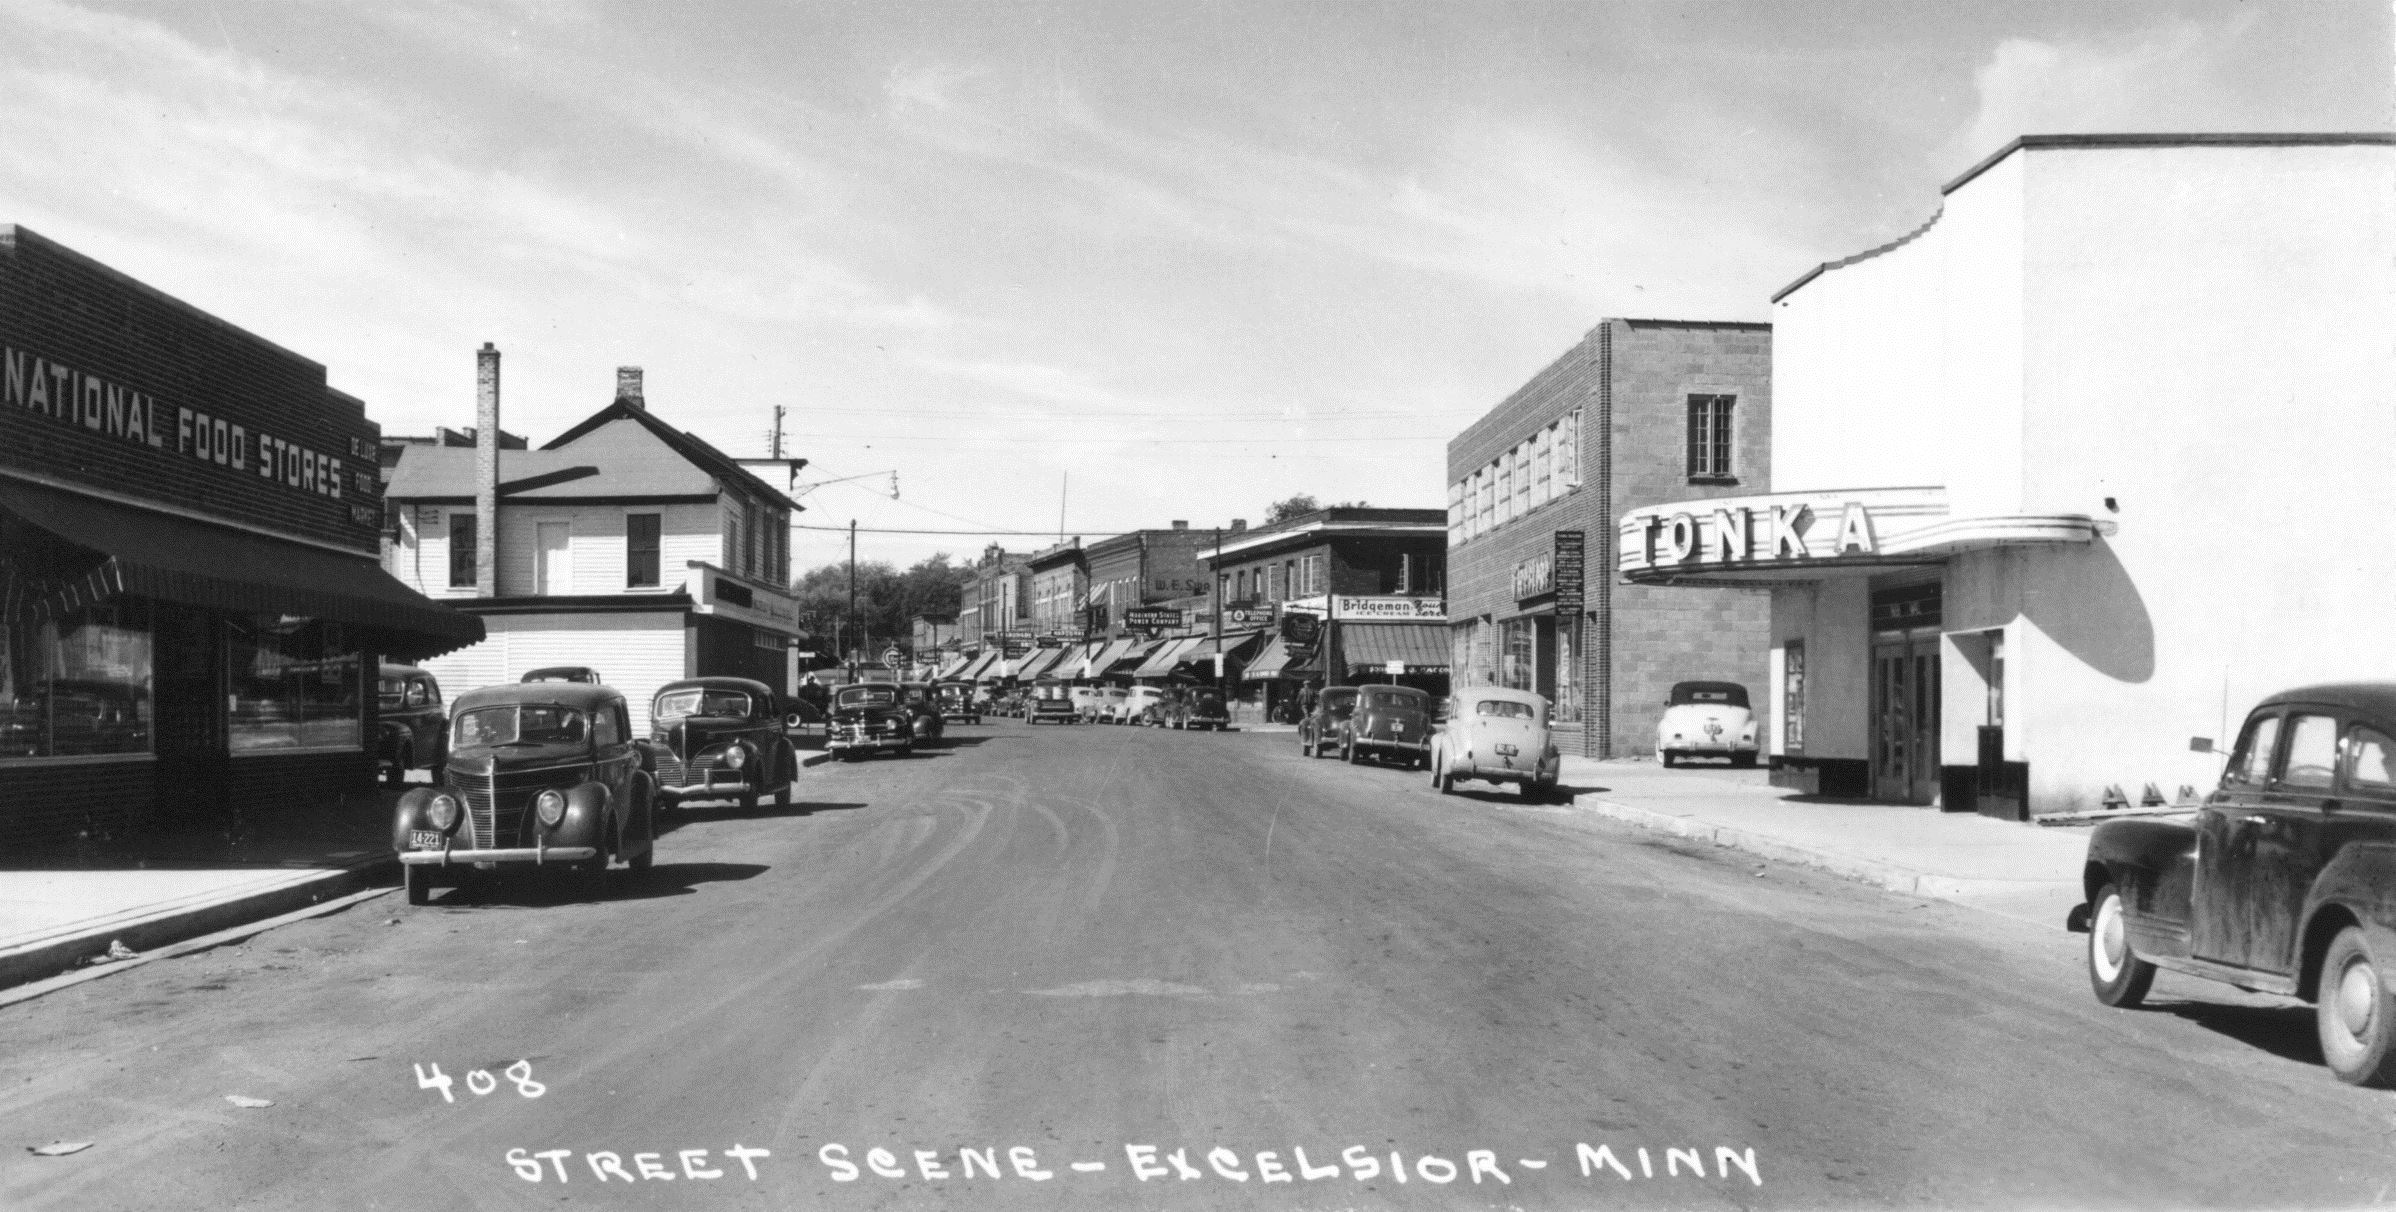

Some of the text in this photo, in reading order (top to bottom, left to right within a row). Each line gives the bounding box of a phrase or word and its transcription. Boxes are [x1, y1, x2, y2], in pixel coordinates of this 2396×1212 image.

[5, 346, 341, 499] NATIONAL FOOD STORES
[1636, 501, 1878, 564] TONKA
[411, 832, 440, 846] 14-221
